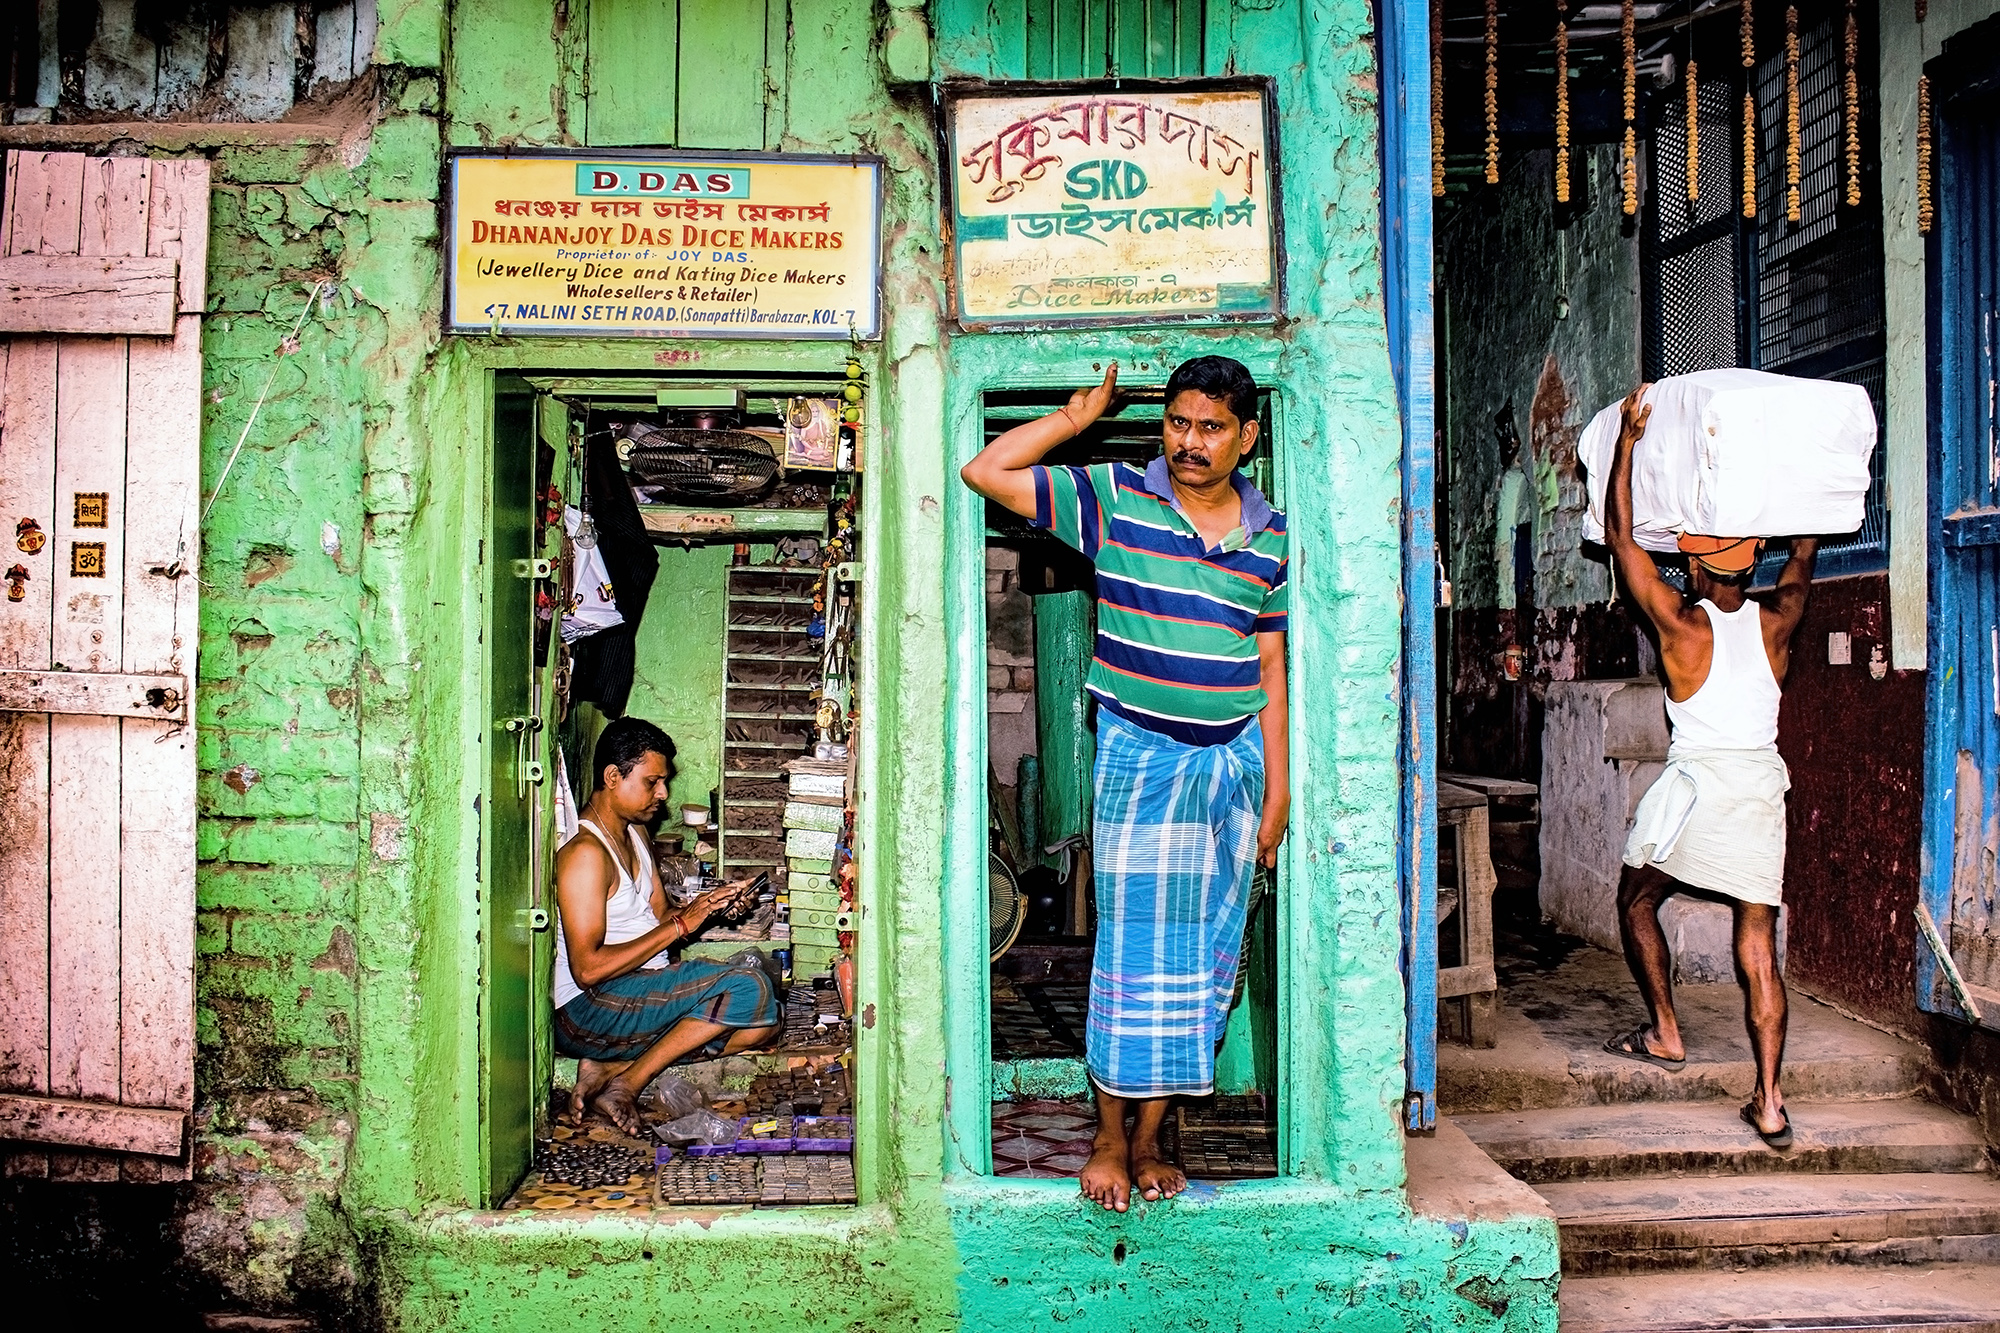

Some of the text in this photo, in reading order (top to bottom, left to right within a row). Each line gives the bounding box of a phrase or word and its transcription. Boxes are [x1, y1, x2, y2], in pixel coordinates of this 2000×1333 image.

[1064, 159, 1148, 201] SKD
[590, 200, 643, 218] দাস
[652, 198, 725, 222] ডাইস
[737, 201, 831, 223] মেকার্স
[471, 219, 843, 250] DHANANJOY DAS DICE MAKERS
[1011, 202, 1137, 247] ডাইস
[556, 248, 631, 263] Proprietor
[666, 250, 702, 262] JOY
[712, 251, 755, 264] DAS.
[476, 256, 847, 287] (Jewellery Dice and Kating Dice Makers
[566, 284, 759, 305] Wholesellers & Retailer)
[1005, 284, 1214, 310] Dice Makers
[516, 304, 577, 321] NALINI
[581, 305, 627, 321] SETH
